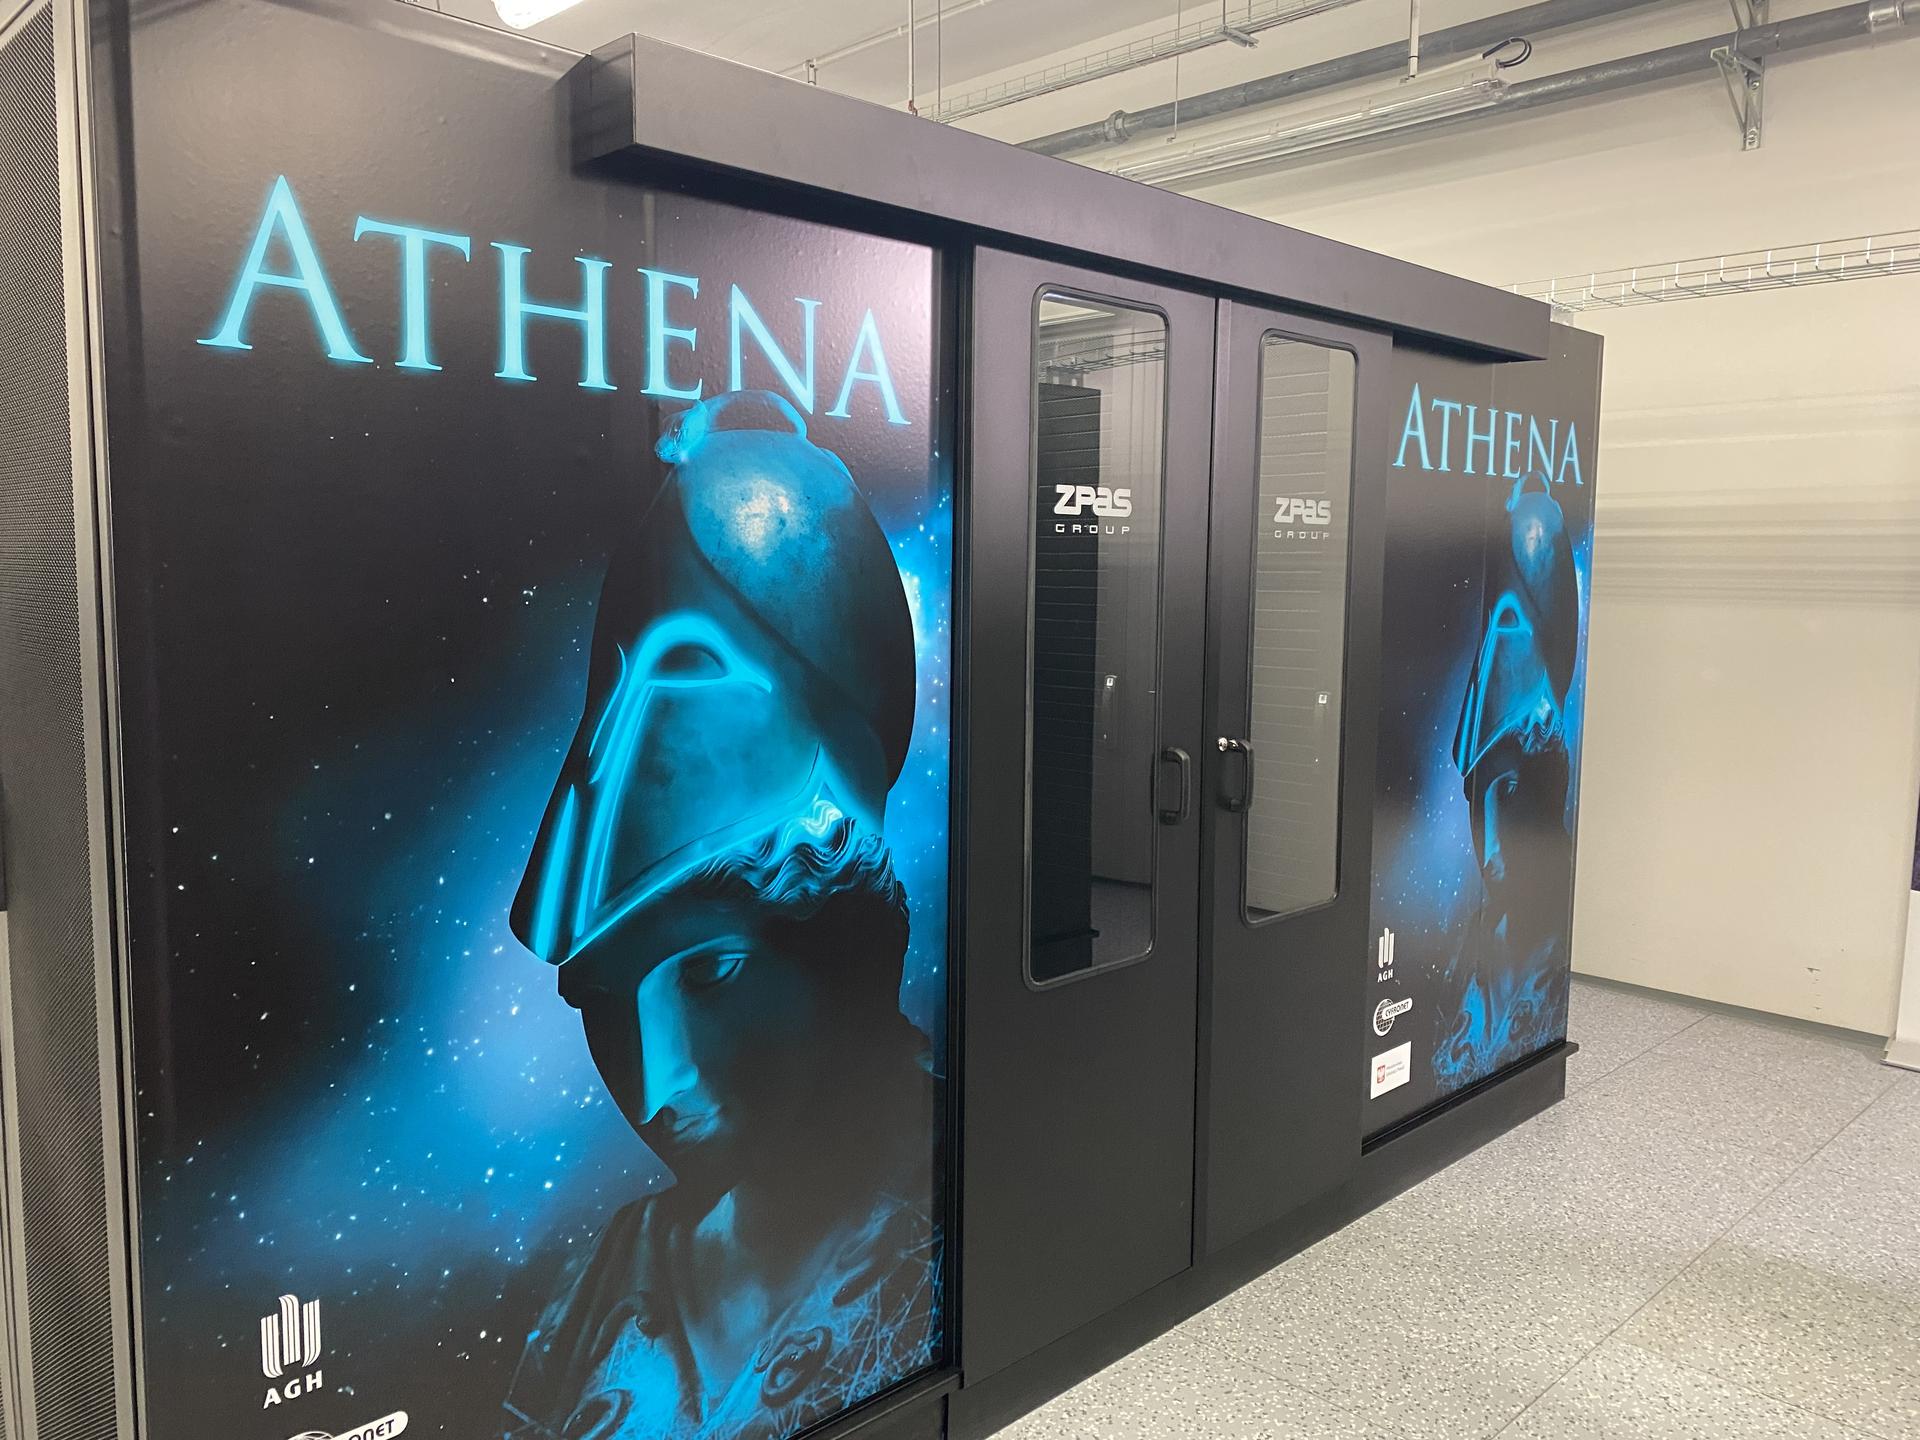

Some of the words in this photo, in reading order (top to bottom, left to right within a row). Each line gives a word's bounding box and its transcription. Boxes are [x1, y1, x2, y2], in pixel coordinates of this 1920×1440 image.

[197, 174, 912, 426] ATHENA
[1392, 382, 1584, 485] ATHENA
[1055, 523, 1130, 535] GROUP
[1274, 529, 1330, 540] GROUP
[1377, 968, 1394, 983] AGH
[263, 1369, 323, 1410] AGH
